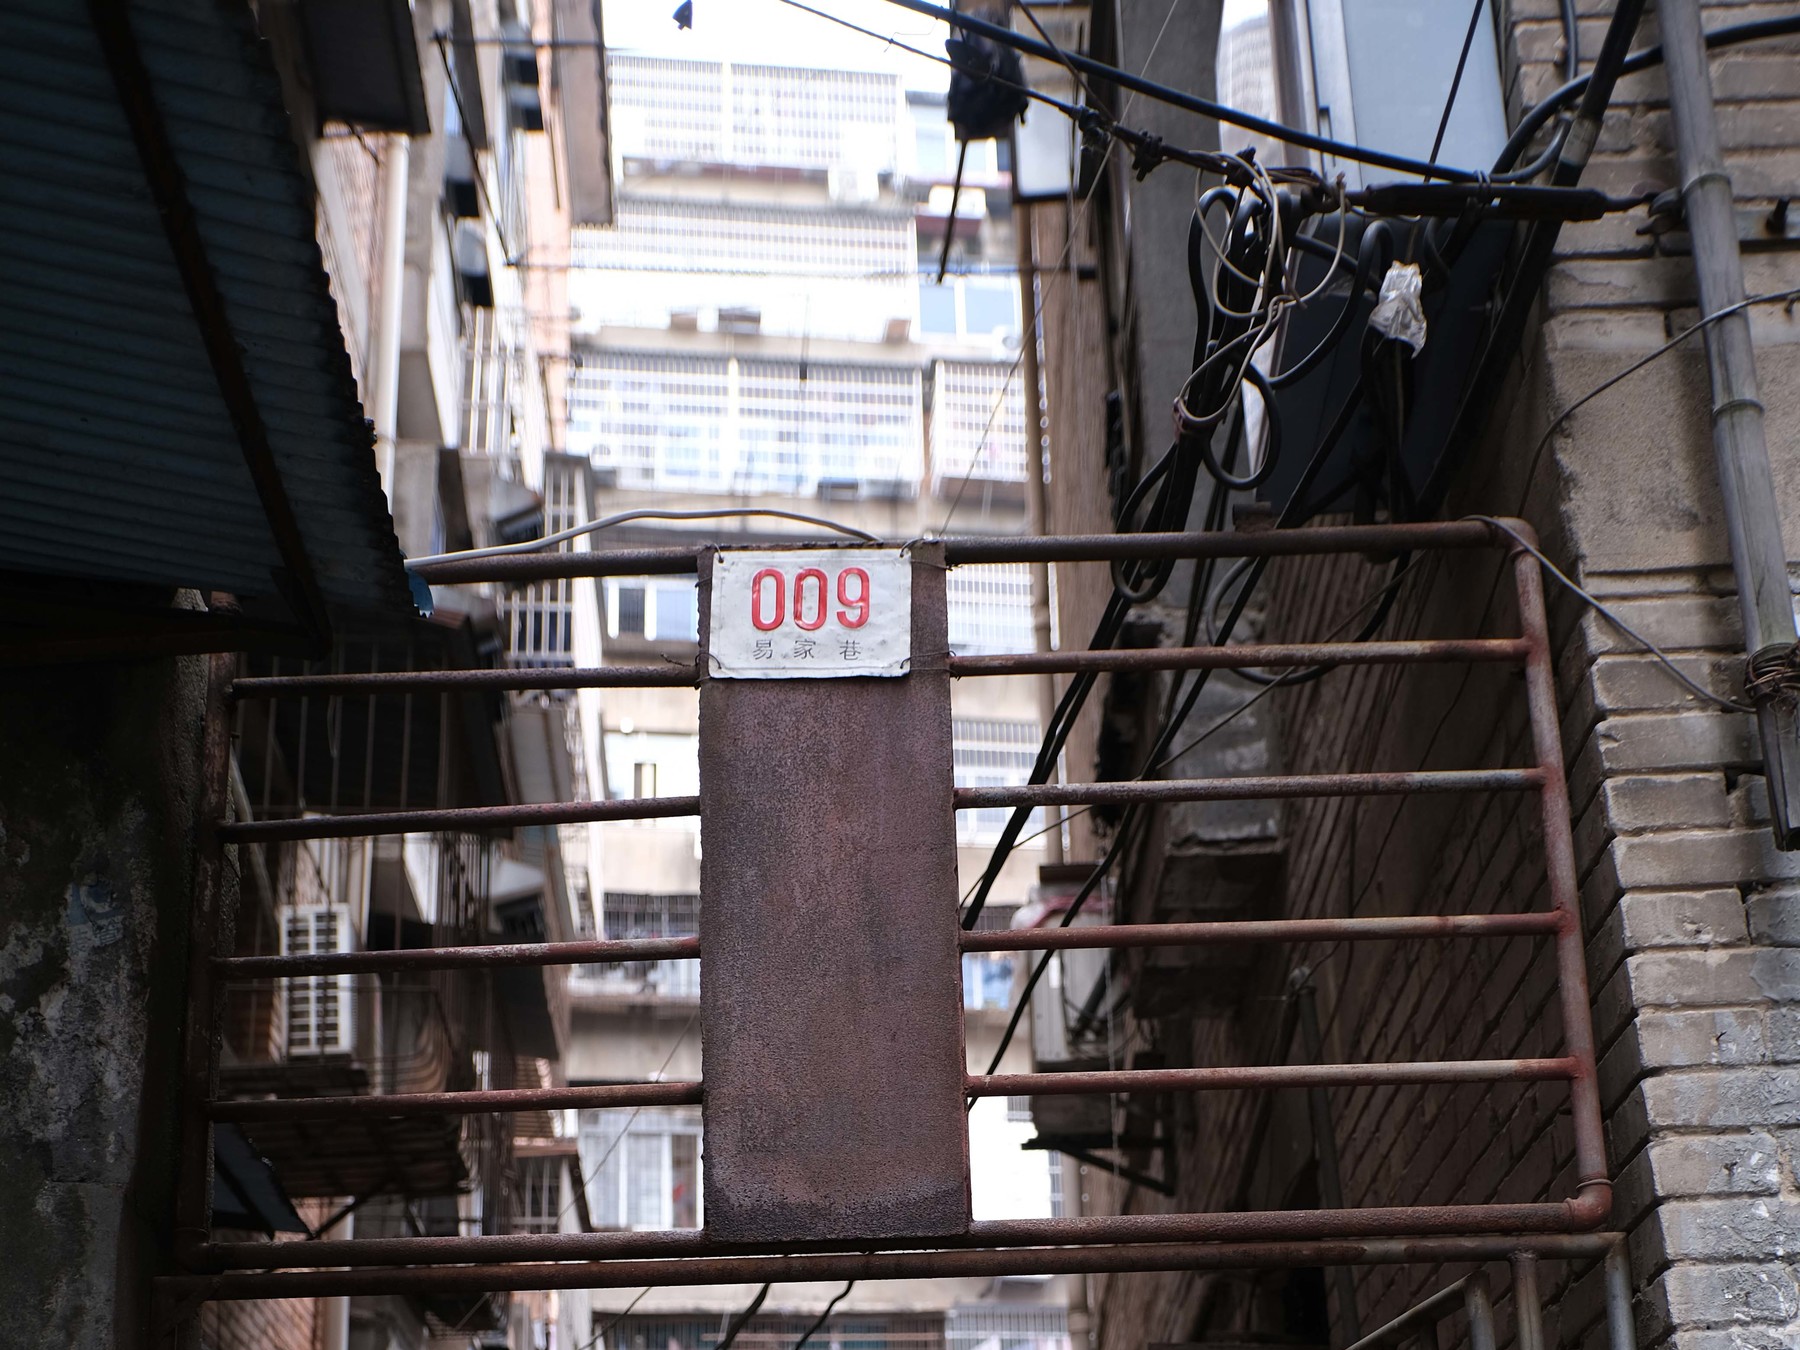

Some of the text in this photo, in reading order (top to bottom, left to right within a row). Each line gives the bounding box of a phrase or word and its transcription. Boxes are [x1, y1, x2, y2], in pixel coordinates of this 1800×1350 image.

[751, 567, 870, 632] 009
[752, 638, 862, 661] 易家巷
